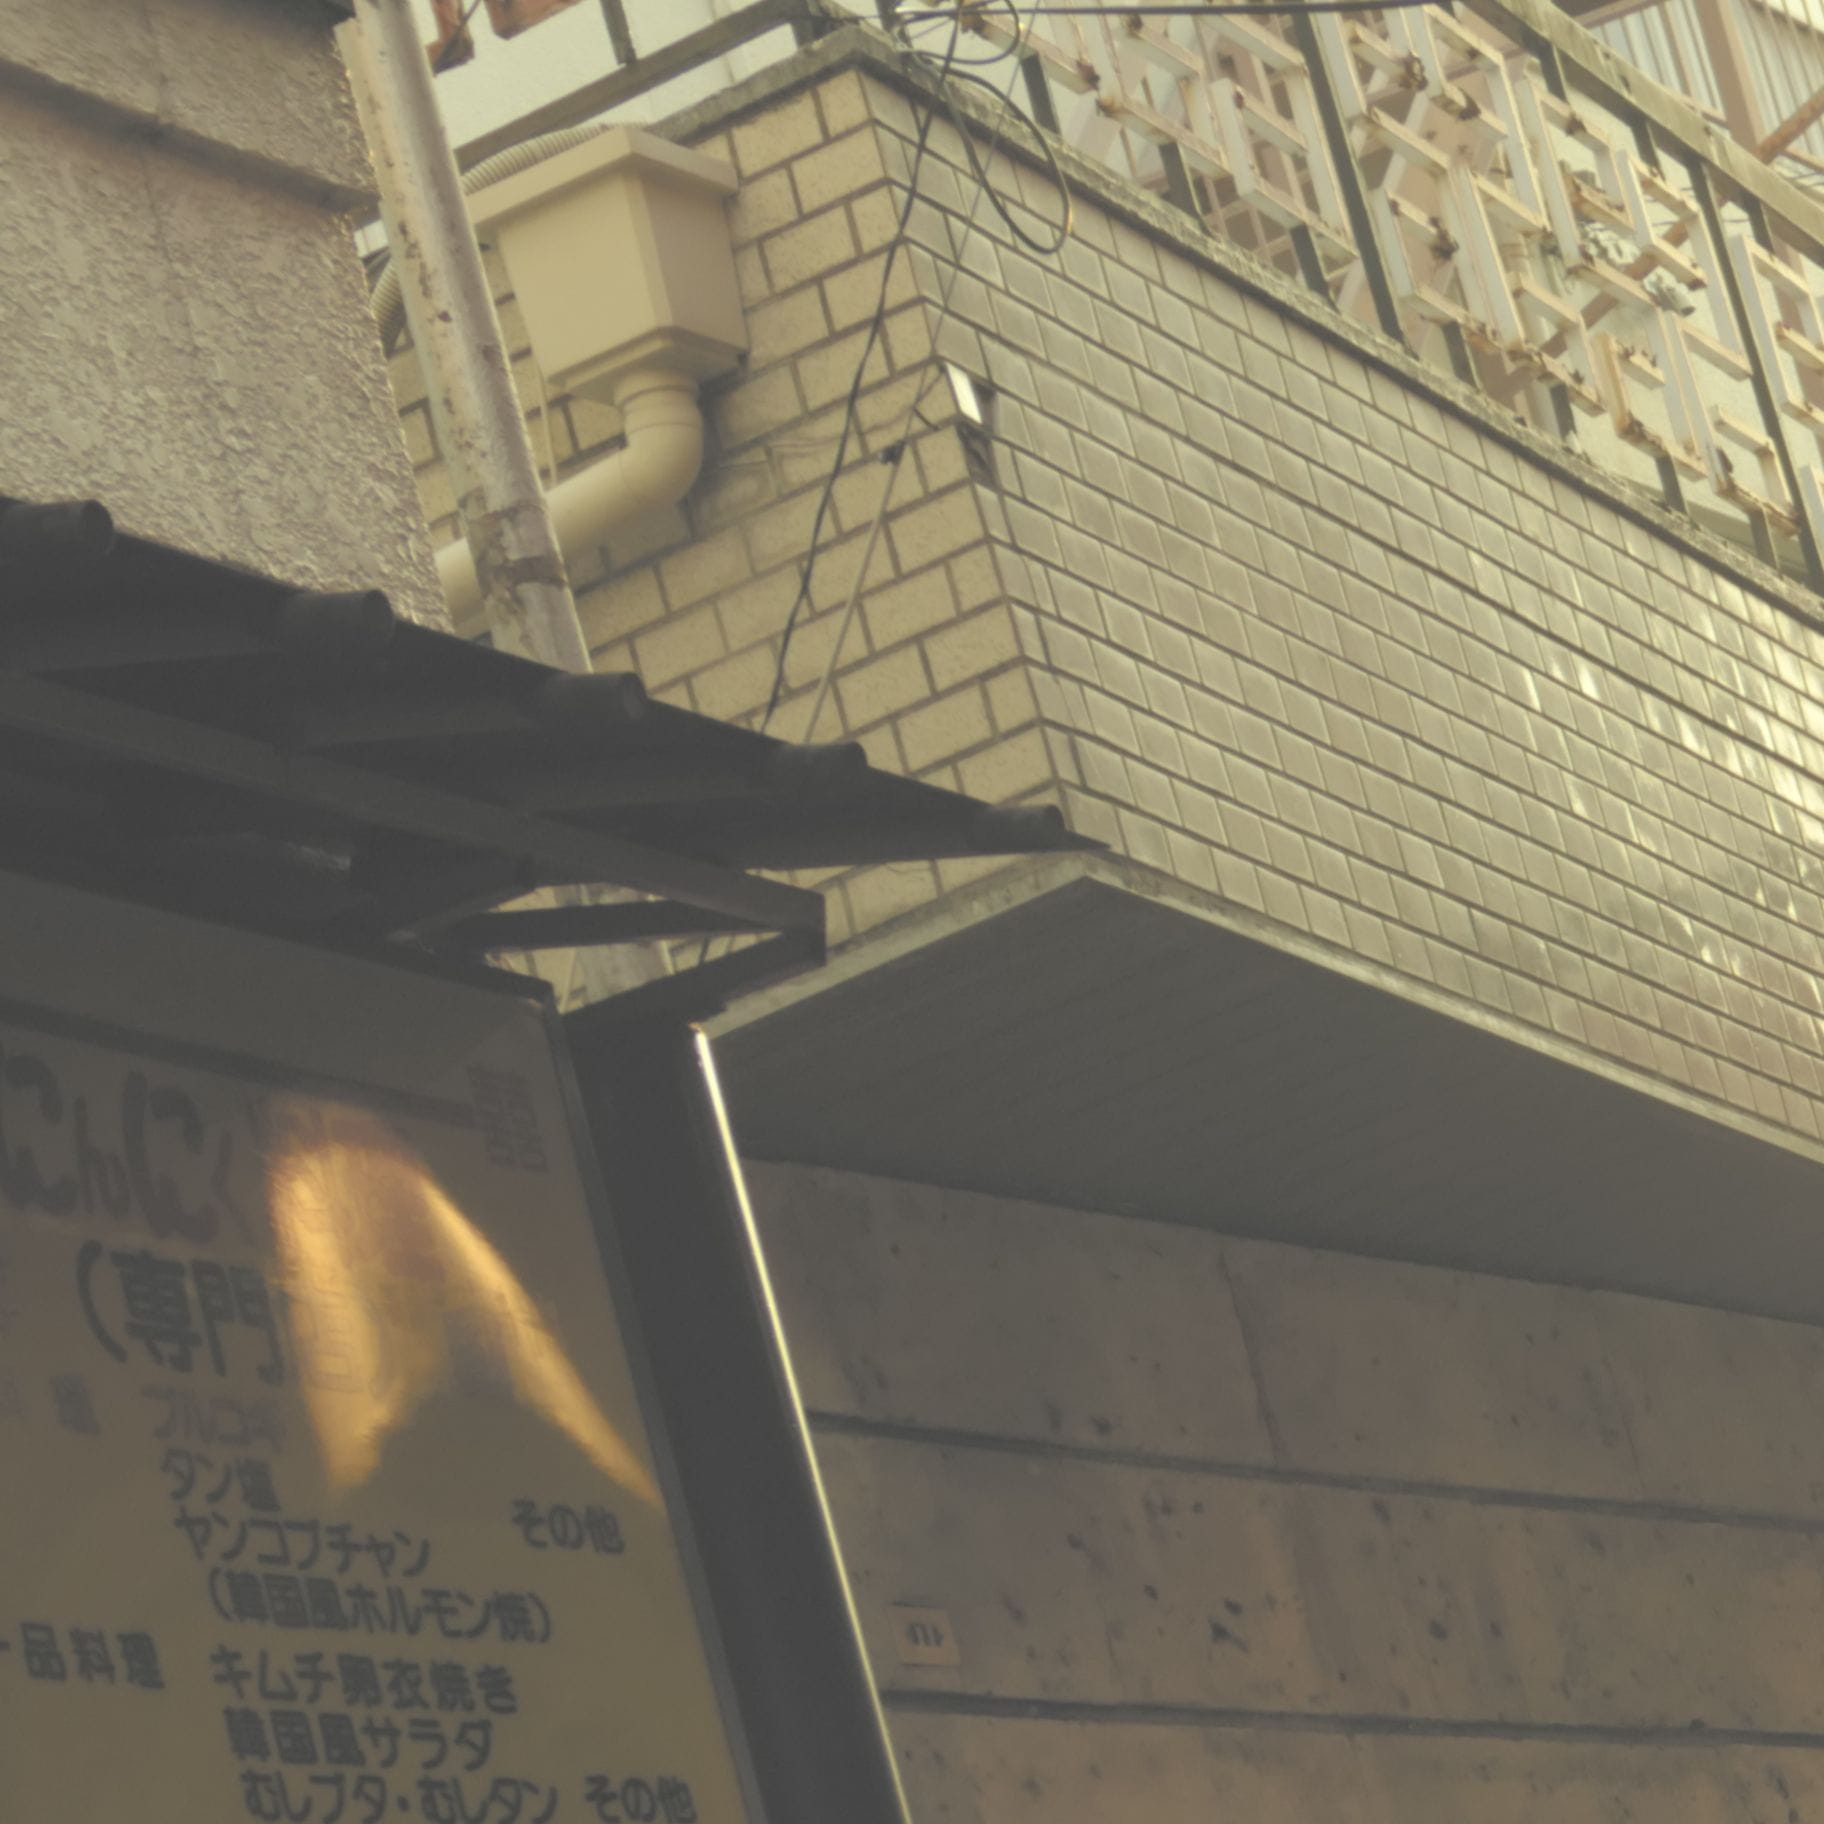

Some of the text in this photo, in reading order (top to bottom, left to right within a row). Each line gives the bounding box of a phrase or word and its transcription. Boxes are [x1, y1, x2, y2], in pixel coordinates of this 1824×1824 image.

[511, 1499, 624, 1555] その他
[223, 1706, 492, 1771] 韓国風サラダ
